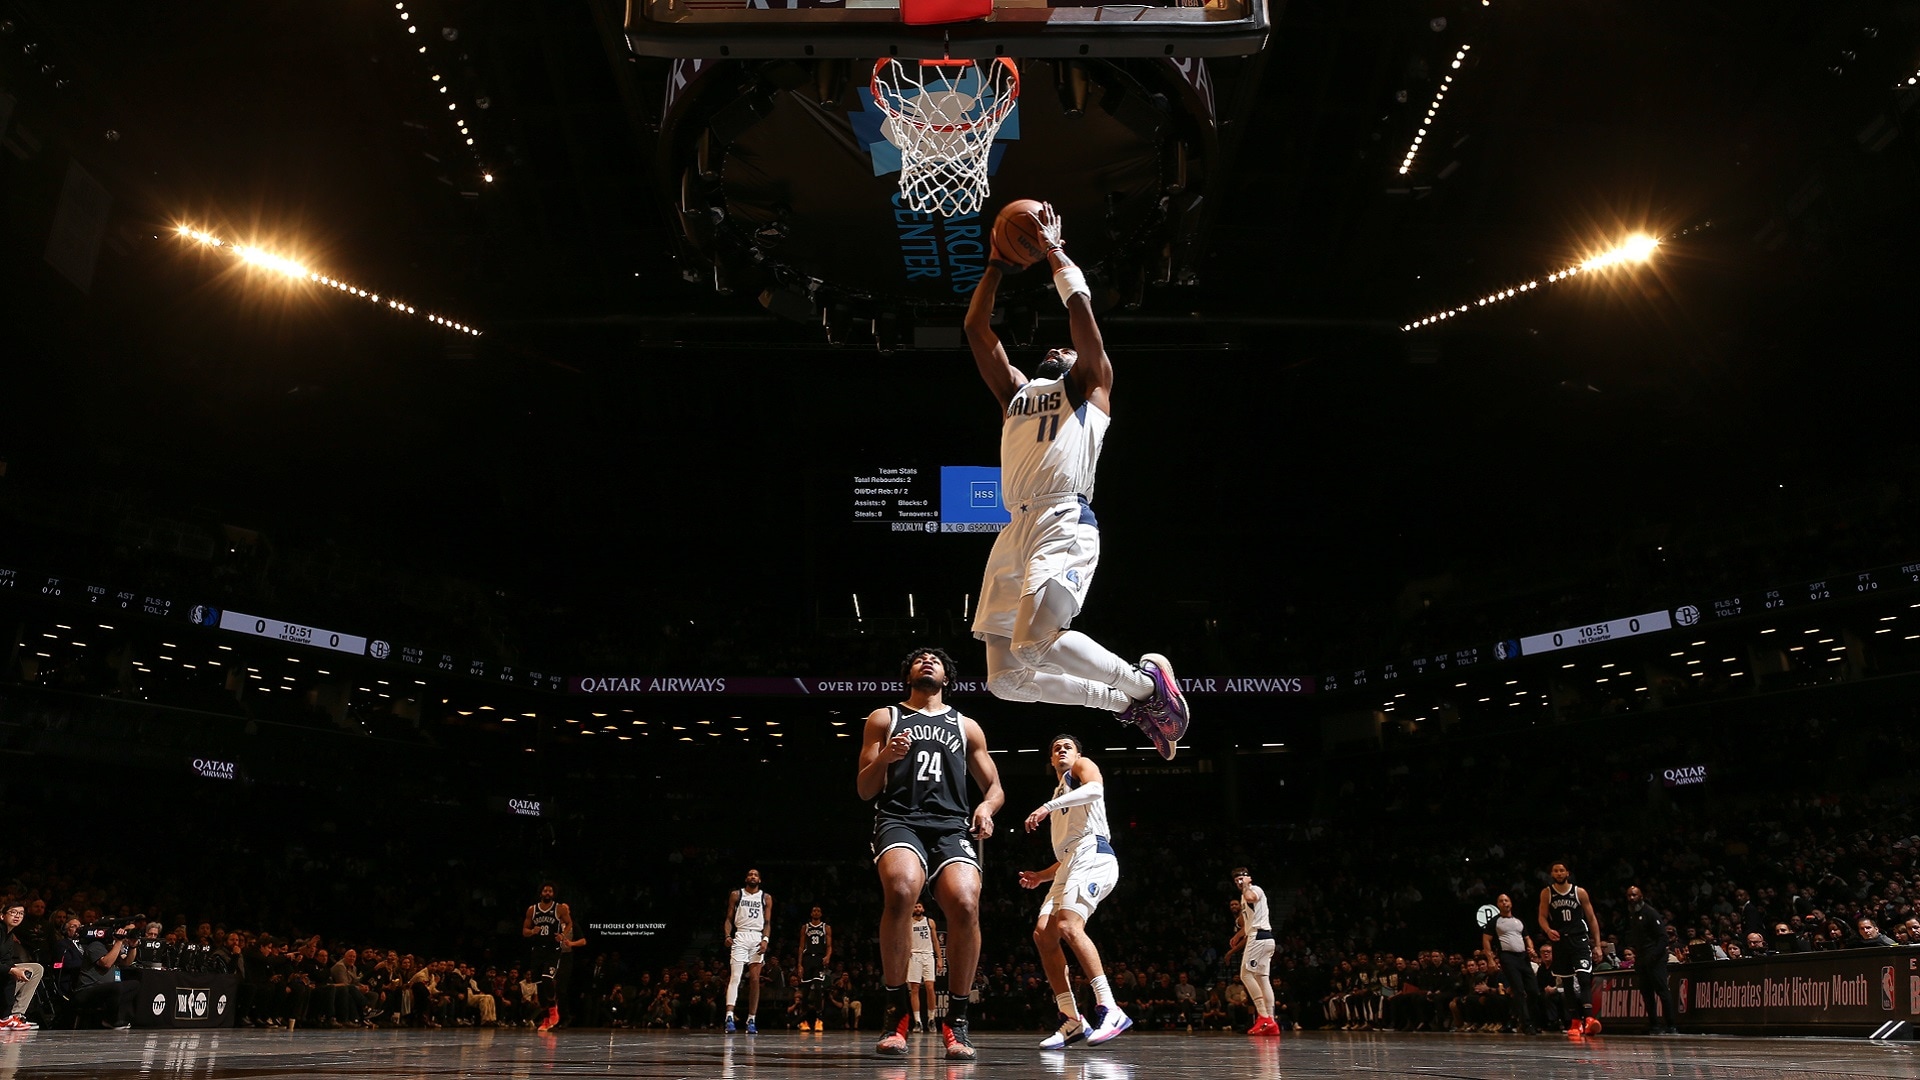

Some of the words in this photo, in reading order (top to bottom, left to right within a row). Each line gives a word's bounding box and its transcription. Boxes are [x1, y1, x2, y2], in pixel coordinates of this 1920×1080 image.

[1036, 414, 1060, 442] 11
[892, 523, 923, 532] BROOKLYN
[47, 578, 59, 586] FT
[1858, 573, 1870, 582] FT
[87, 585, 105, 595] REB
[1810, 582, 1826, 591] 3PT
[117, 592, 135, 600] AST
[1766, 591, 1780, 599] FG
[255, 619, 266, 633] 0
[283, 624, 312, 638] 10:51
[1579, 624, 1609, 638] 10:51
[1629, 618, 1640, 632] 0
[289, 635, 312, 644] Quarter
[329, 634, 339, 647] 0
[1553, 633, 1563, 647] 0
[1588, 634, 1611, 643] Quarter
[580, 677, 641, 692] QATAR
[648, 677, 726, 692] AIRWAYS
[818, 681, 853, 692] OVER
[857, 681, 876, 692] 170
[1175, 678, 1217, 692] ATAR
[1225, 678, 1302, 692] AIRWAYS
[193, 759, 234, 772] QATAR
[916, 751, 942, 782] 24
[201, 770, 232, 779] AIRWAYS
[1664, 766, 1706, 781] QATAR
[509, 799, 540, 810] QATAR
[1551, 898, 1578, 910] BROOKLYN
[748, 908, 759, 918] 55
[1562, 909, 1572, 922] 10
[1603, 978, 1632, 988] BUIL
[1695, 983, 1711, 1008] NBA
[1712, 980, 1761, 1008] Celebrates
[1763, 977, 1790, 1007] Black
[1792, 976, 1830, 1011] History
[1832, 974, 1868, 1006] Month
[1601, 989, 1629, 1017] BLACK
